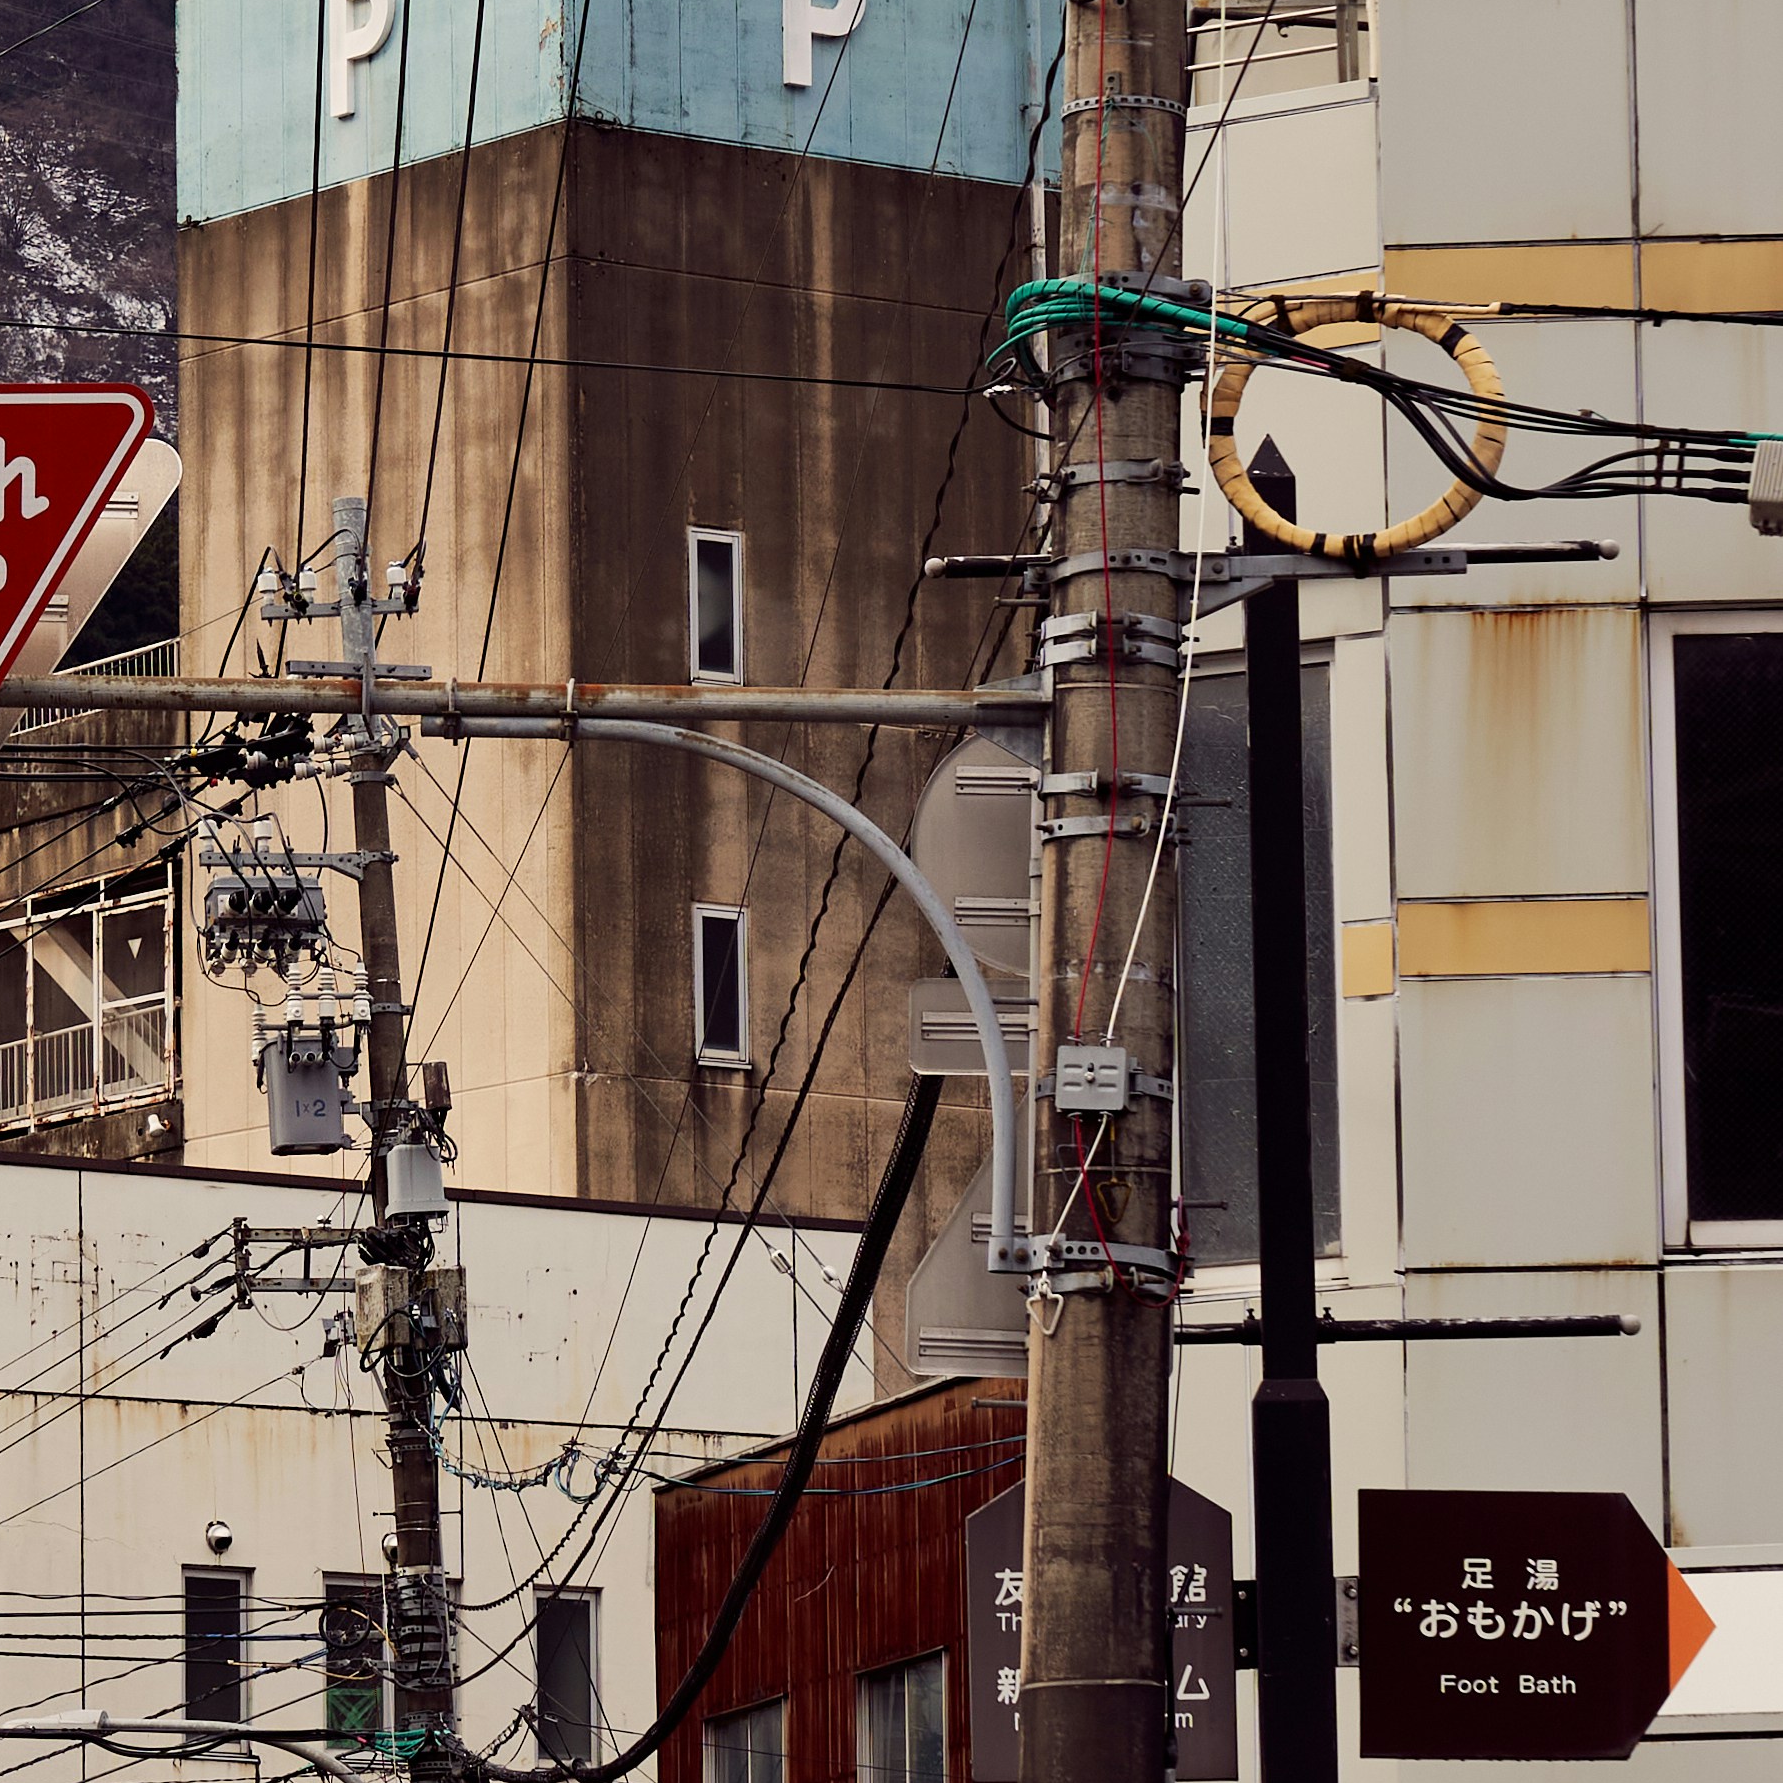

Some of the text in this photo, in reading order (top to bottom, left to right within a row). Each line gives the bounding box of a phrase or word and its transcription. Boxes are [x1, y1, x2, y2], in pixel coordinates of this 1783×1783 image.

[1461, 1557, 1561, 1591] 足湯
[1439, 1673, 1578, 1695] Foot Bath
